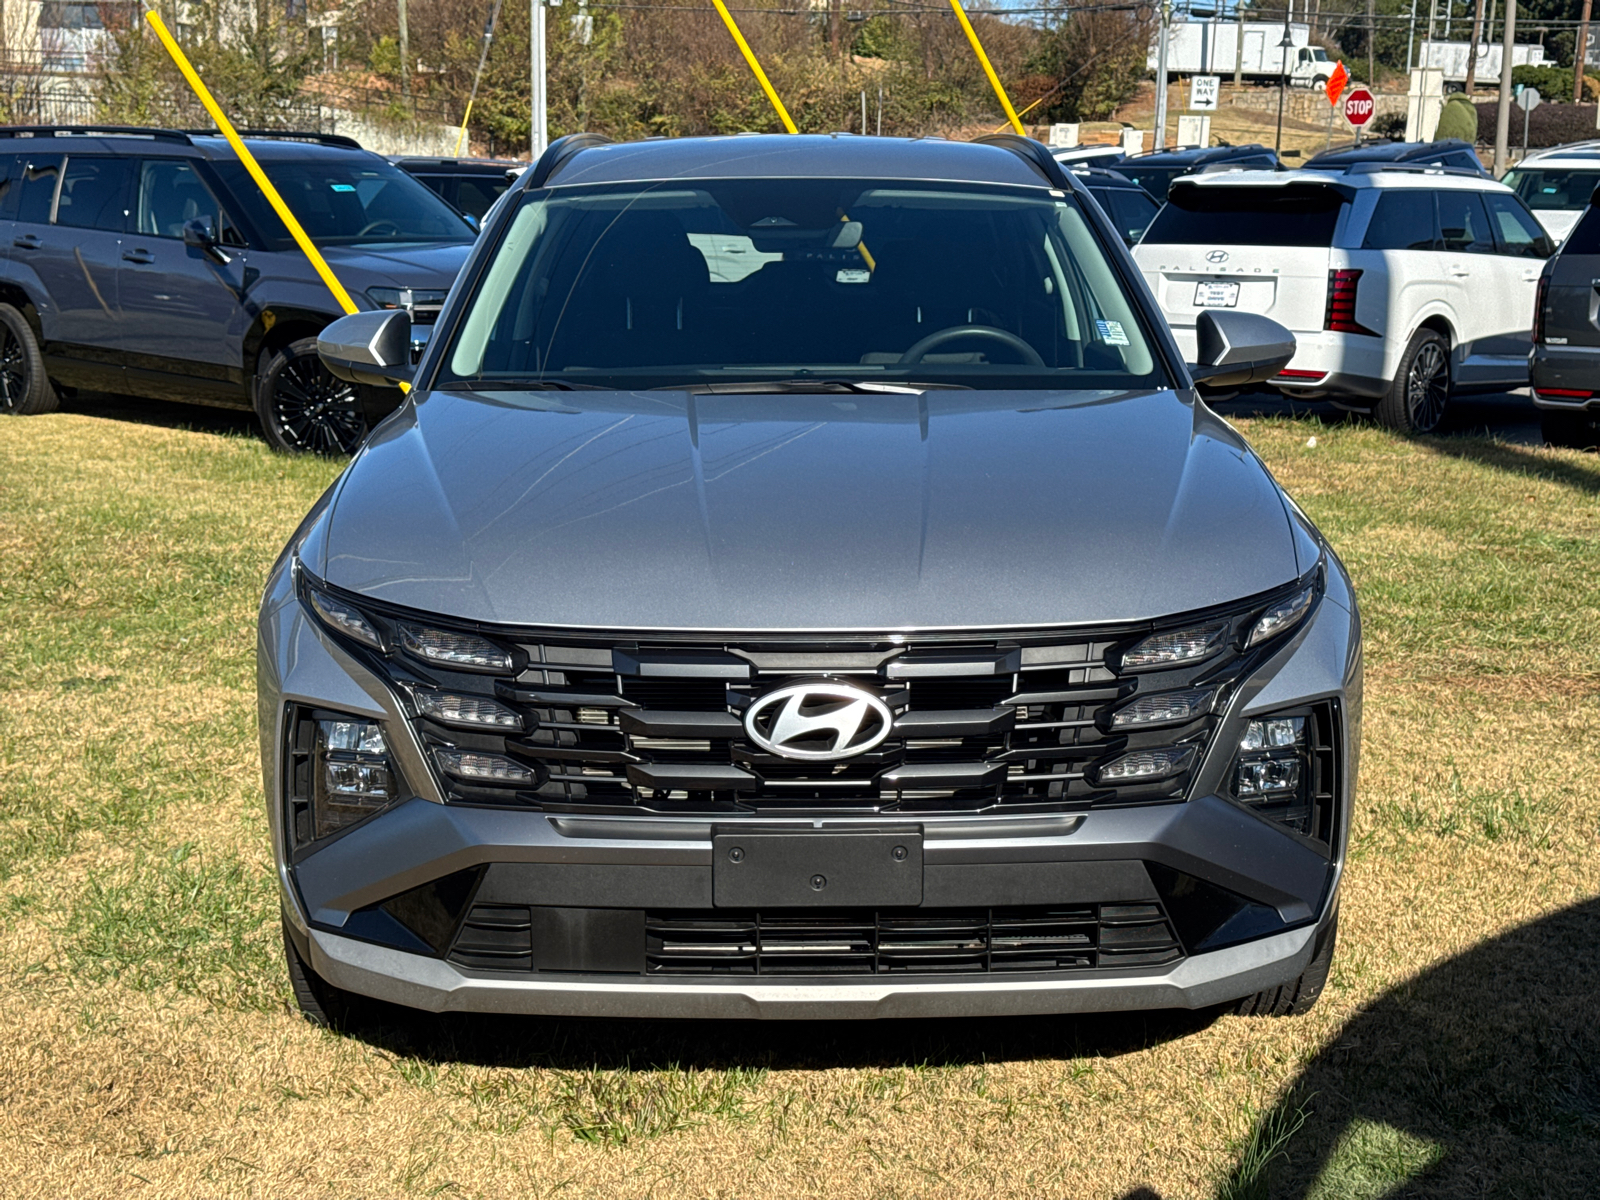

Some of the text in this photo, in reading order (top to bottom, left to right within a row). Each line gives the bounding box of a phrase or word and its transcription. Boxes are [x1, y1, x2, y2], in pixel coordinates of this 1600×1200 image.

[1196, 79, 1215, 87] ONE
[1196, 88, 1215, 96] WAY
[1346, 99, 1373, 115] STOP
[1159, 265, 1280, 274] PALISADE
